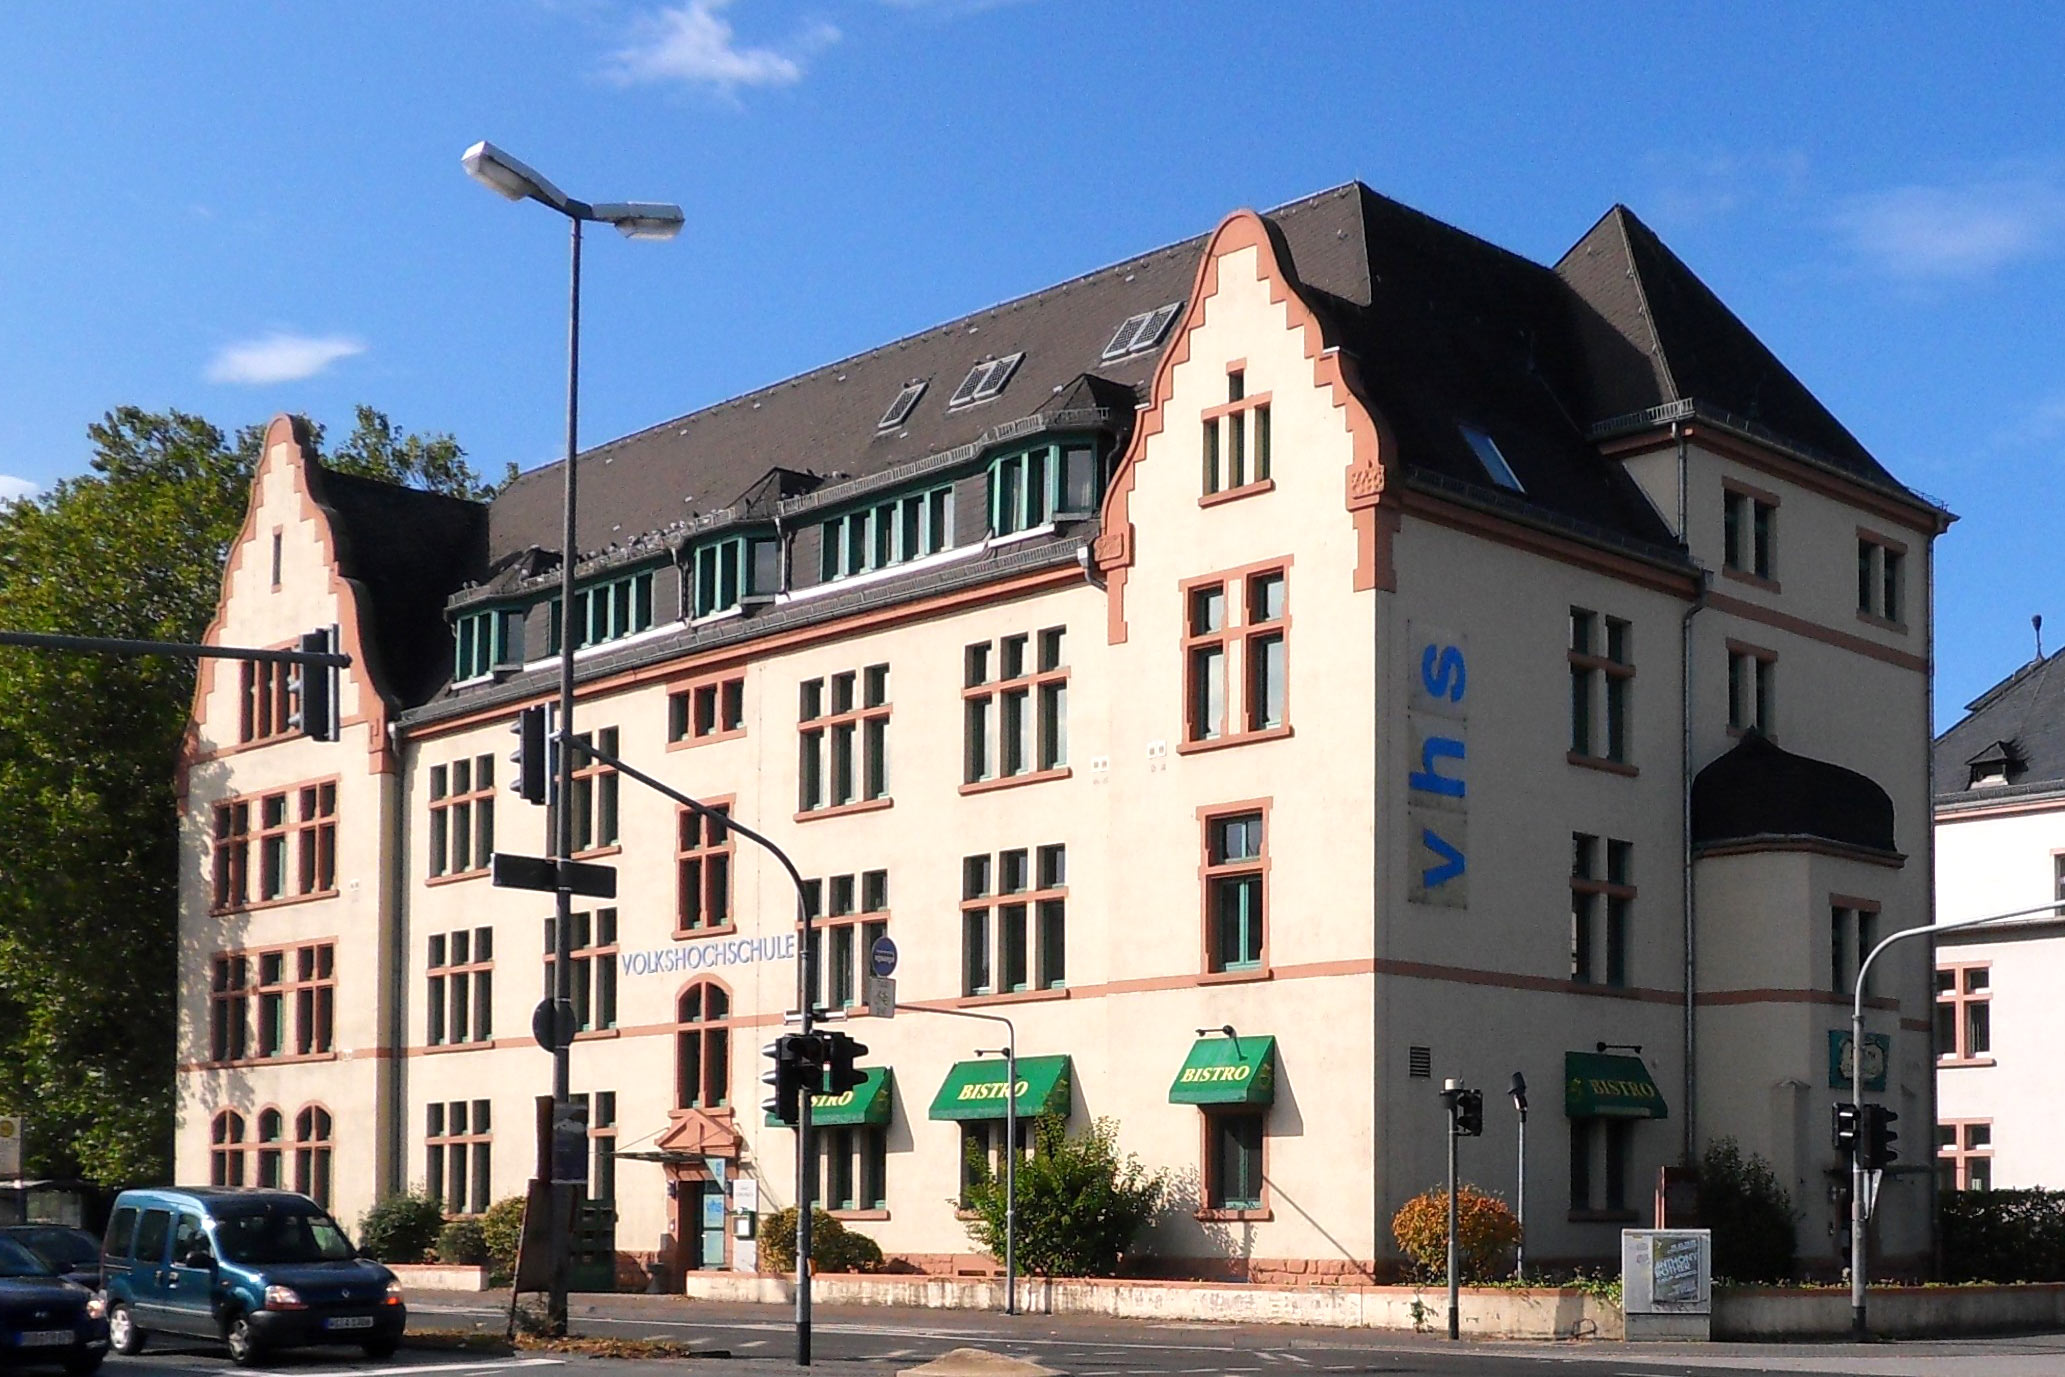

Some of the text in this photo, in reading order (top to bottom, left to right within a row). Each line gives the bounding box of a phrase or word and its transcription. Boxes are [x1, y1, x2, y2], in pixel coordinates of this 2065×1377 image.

[1409, 643, 1467, 888] vhs
[622, 934, 795, 976] VOLKSHOCHSCHULE
[1180, 1065, 1250, 1083] BISTRO
[956, 1081, 1029, 1100] BISTRO
[1590, 1079, 1655, 1097] BISTRO
